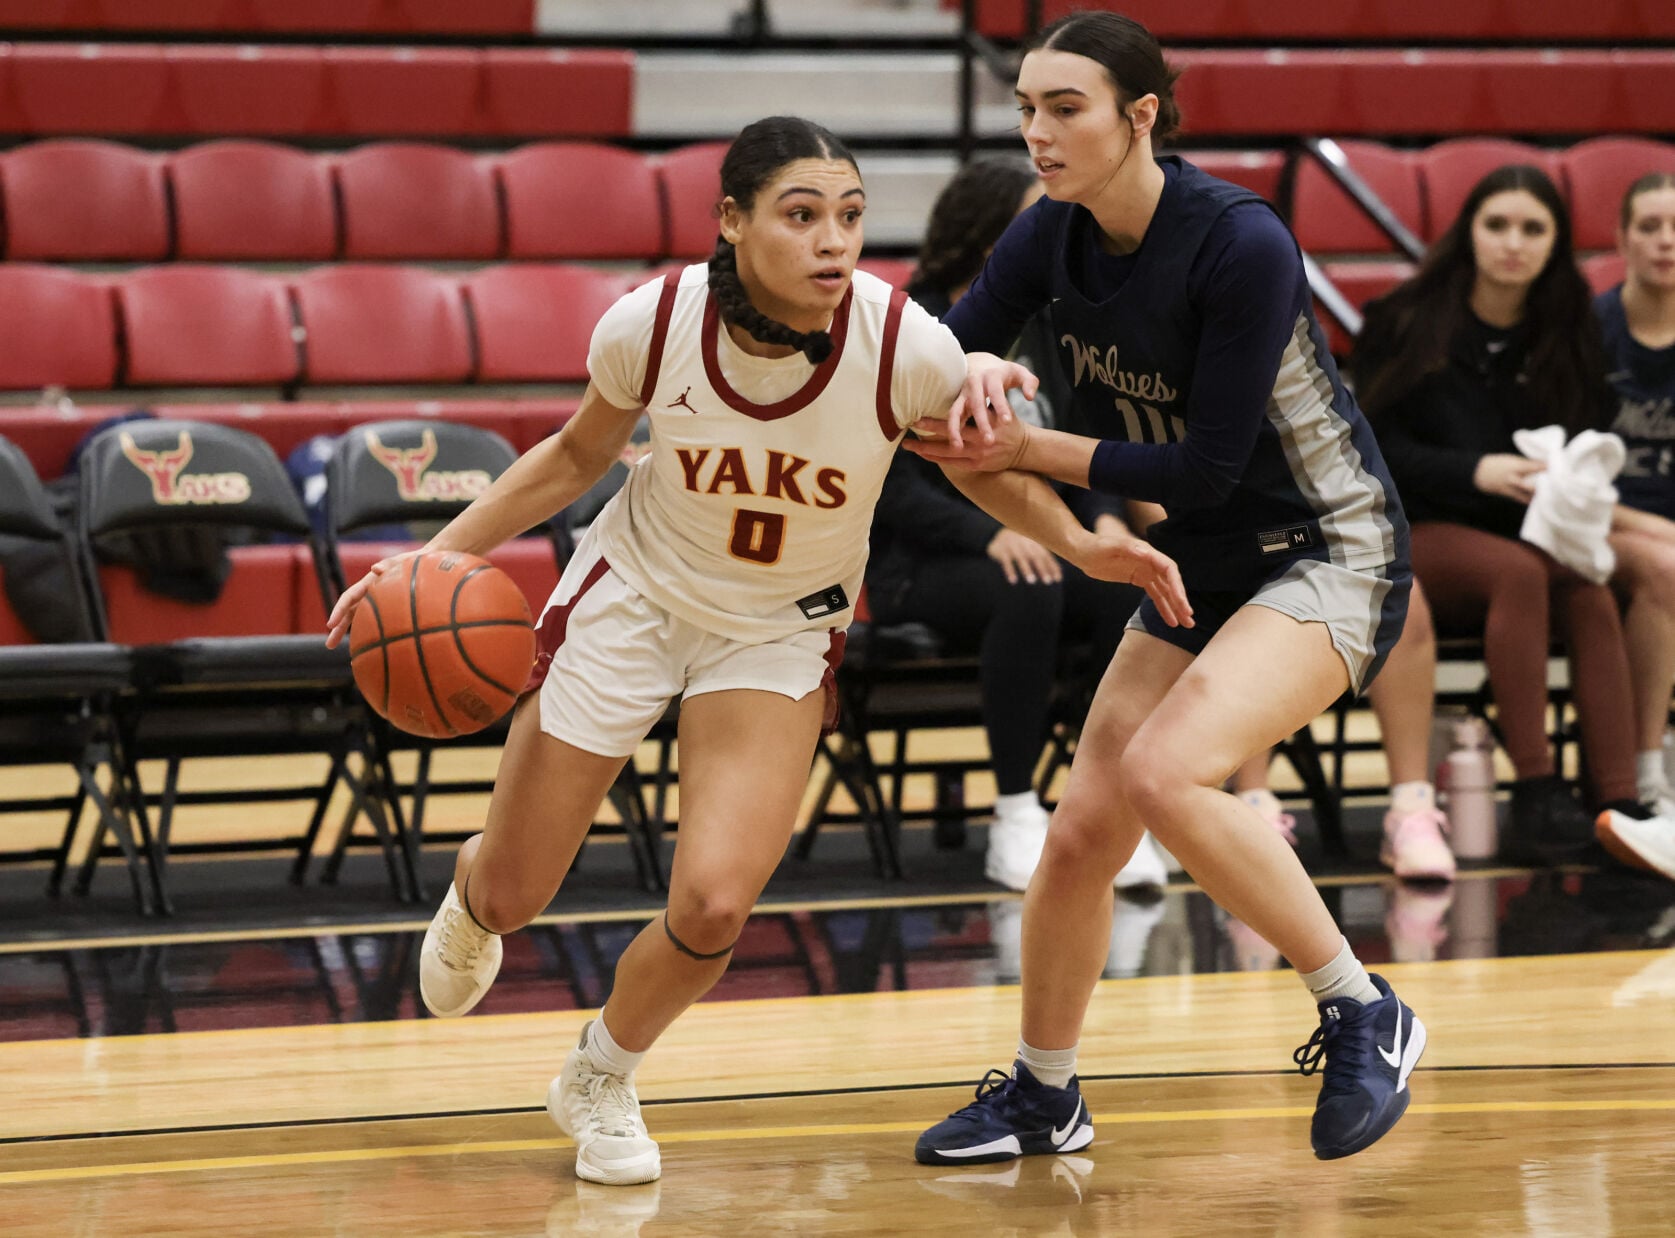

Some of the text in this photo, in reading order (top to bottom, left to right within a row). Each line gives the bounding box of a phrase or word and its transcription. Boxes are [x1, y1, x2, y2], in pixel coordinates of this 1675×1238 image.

[1060, 333, 1177, 402] Wolves
[673, 447, 848, 510] YAKS
[727, 507, 788, 568] 0
[1293, 533, 1305, 544] M
[831, 594, 840, 604] S
